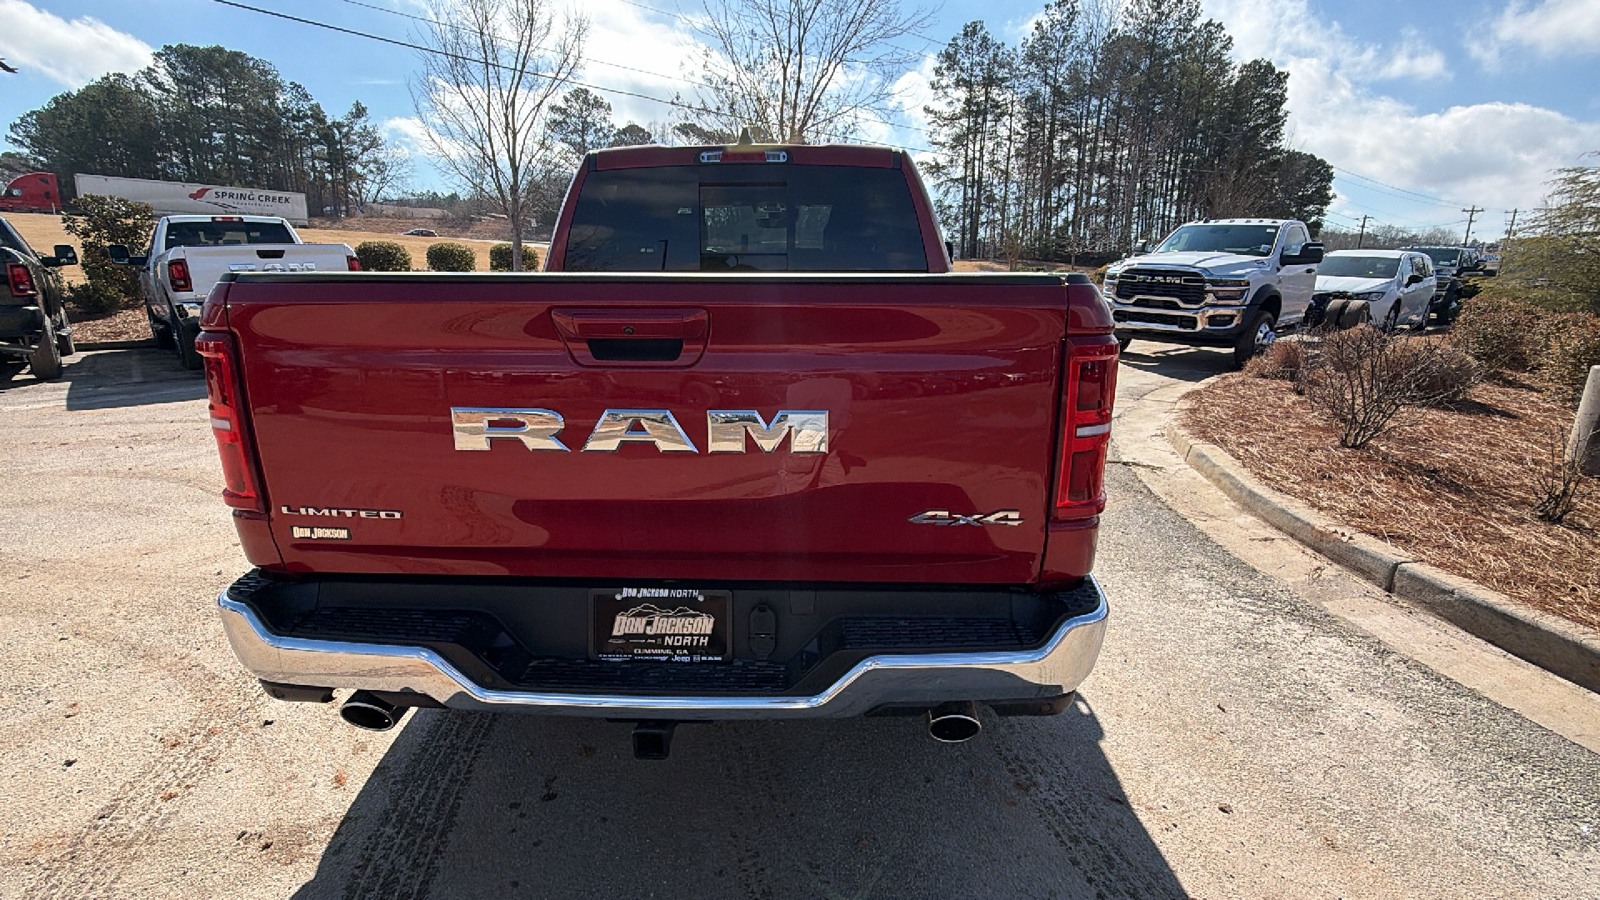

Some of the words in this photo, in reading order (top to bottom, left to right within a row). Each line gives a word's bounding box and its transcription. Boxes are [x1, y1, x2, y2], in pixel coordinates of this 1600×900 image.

[214, 191, 255, 201] SPRING
[257, 194, 291, 204] CREEK
[450, 407, 829, 453] RAM
[281, 505, 403, 520] LIMITED
[292, 526, 311, 539] DON
[311, 527, 348, 539] JACKSON
[621, 587, 637, 598] DON
[637, 587, 669, 598] JACKSON
[670, 589, 699, 598] NORTH
[612, 615, 647, 636] DON
[645, 616, 715, 635] JACKSON
[664, 636, 709, 646] NORTH
[672, 655, 691, 663] Jeep
